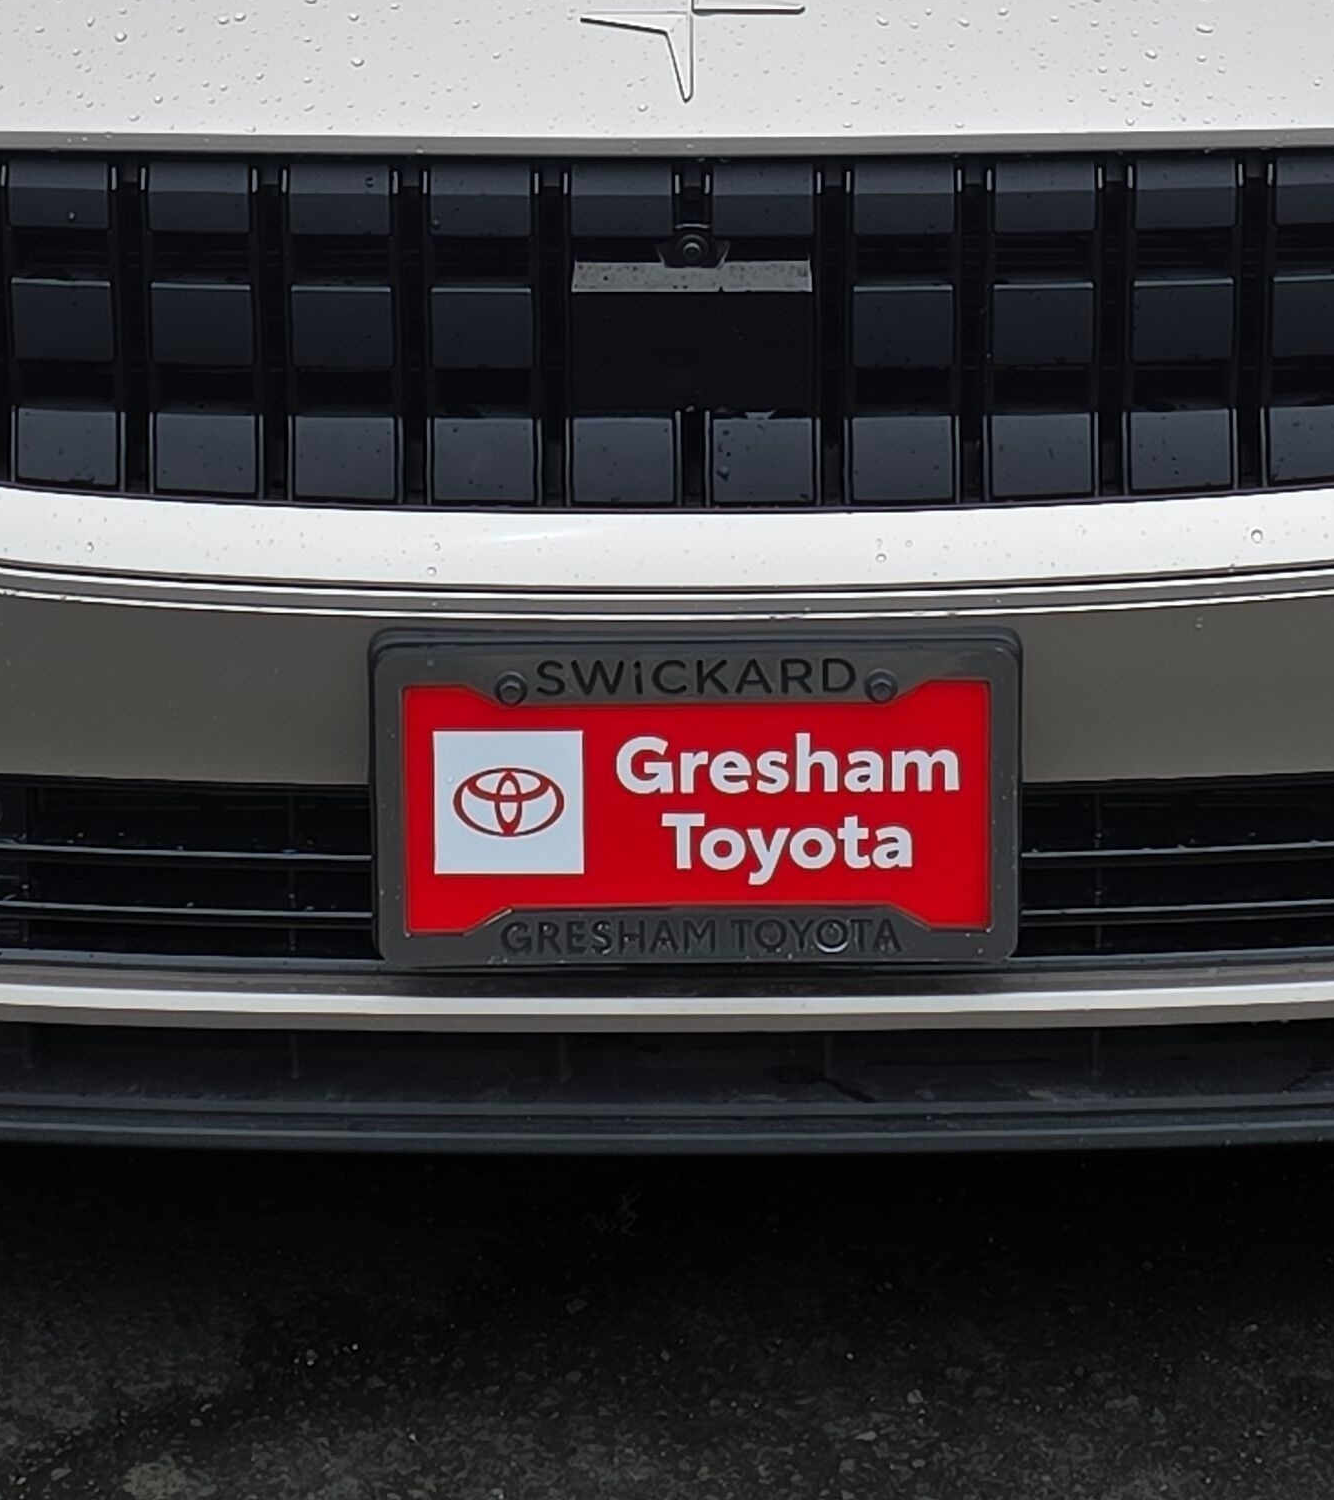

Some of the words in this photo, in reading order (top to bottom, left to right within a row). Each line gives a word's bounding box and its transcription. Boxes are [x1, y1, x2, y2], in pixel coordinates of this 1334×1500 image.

[615, 732, 960, 795] Gresham
[661, 812, 914, 886] Toyota
[499, 918, 718, 956] GRESHAM
[732, 917, 903, 955] TOYOTA
